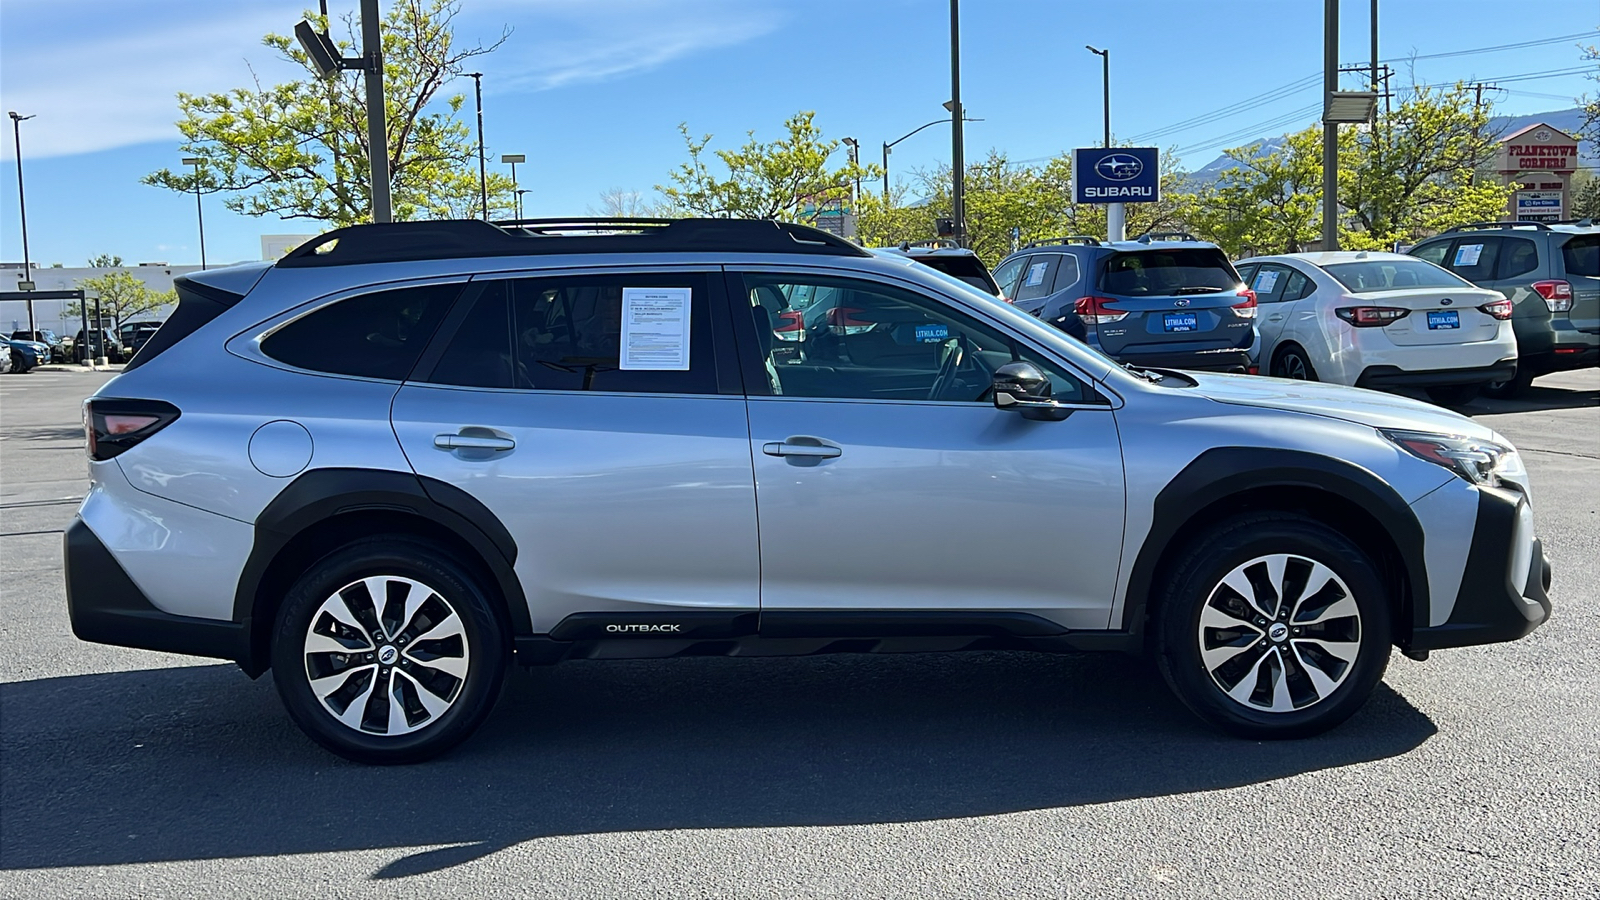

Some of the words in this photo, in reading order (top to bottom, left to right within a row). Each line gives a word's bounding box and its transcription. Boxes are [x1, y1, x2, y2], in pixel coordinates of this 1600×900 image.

[1509, 145, 1577, 156] FRANKTOWN
[1519, 158, 1566, 169] CORNERS
[1085, 186, 1152, 197] SUBARU
[1165, 318, 1196, 327] LITHIA.COM
[1429, 316, 1459, 325] LITHIA.COM
[915, 329, 949, 338] LITHIA.COM
[606, 624, 681, 632] OUTBACK
